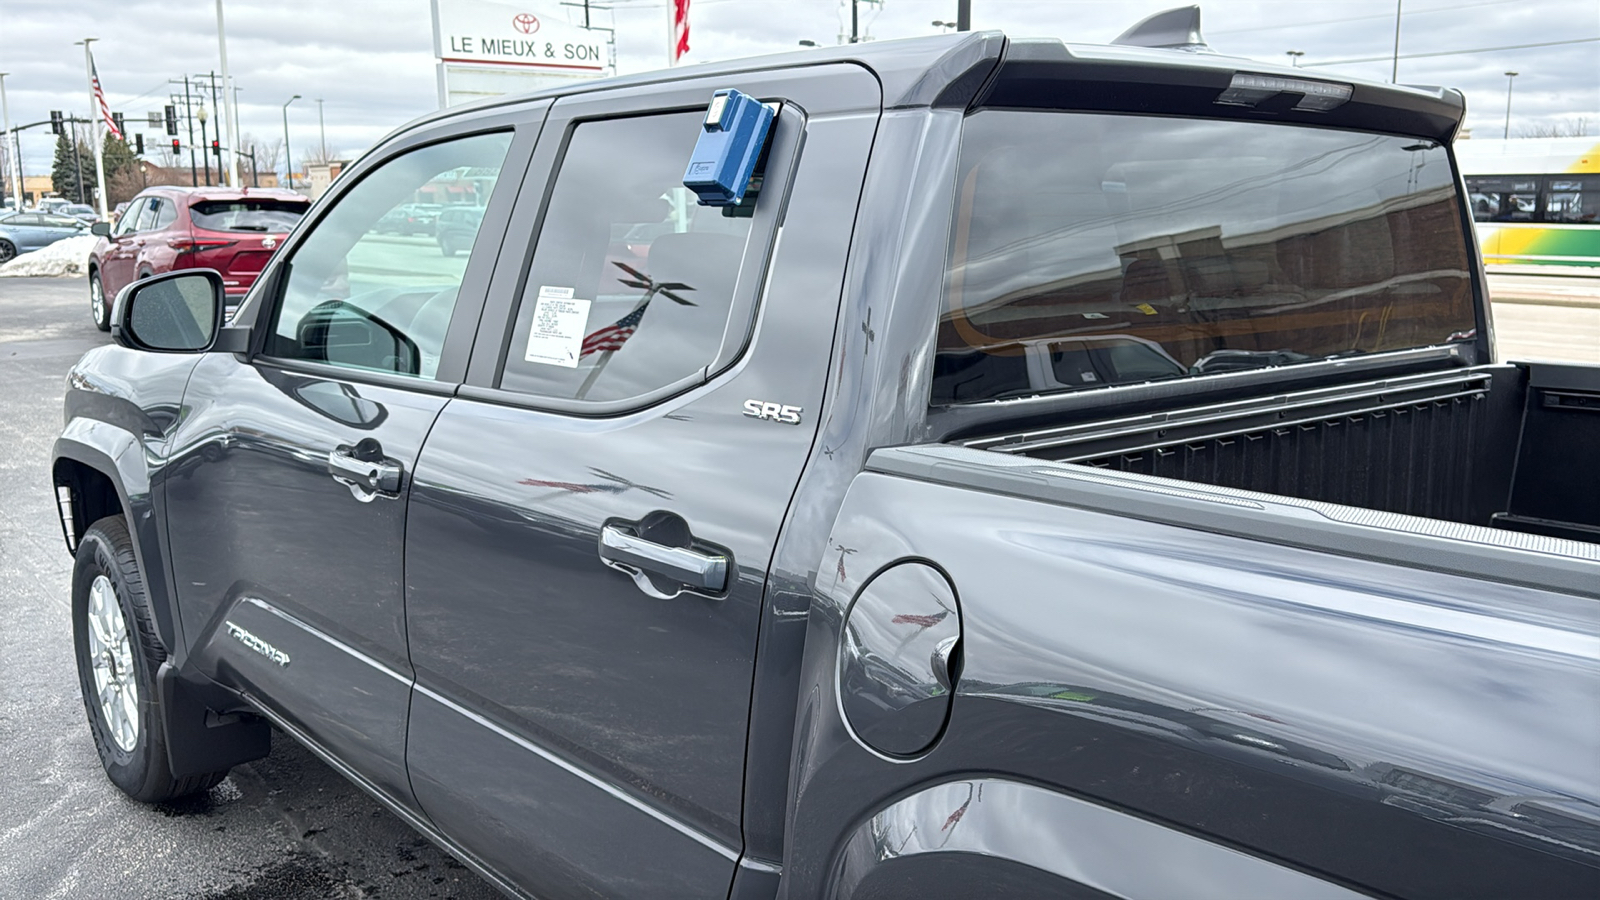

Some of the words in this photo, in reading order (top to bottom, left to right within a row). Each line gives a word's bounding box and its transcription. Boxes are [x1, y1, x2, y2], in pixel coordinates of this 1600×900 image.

[451, 36, 473, 53] LE
[482, 38, 536, 57] MIEUX
[544, 42, 556, 58] &
[564, 43, 600, 61] SON
[742, 399, 803, 425] SR5
[225, 620, 290, 667] TACOMA
